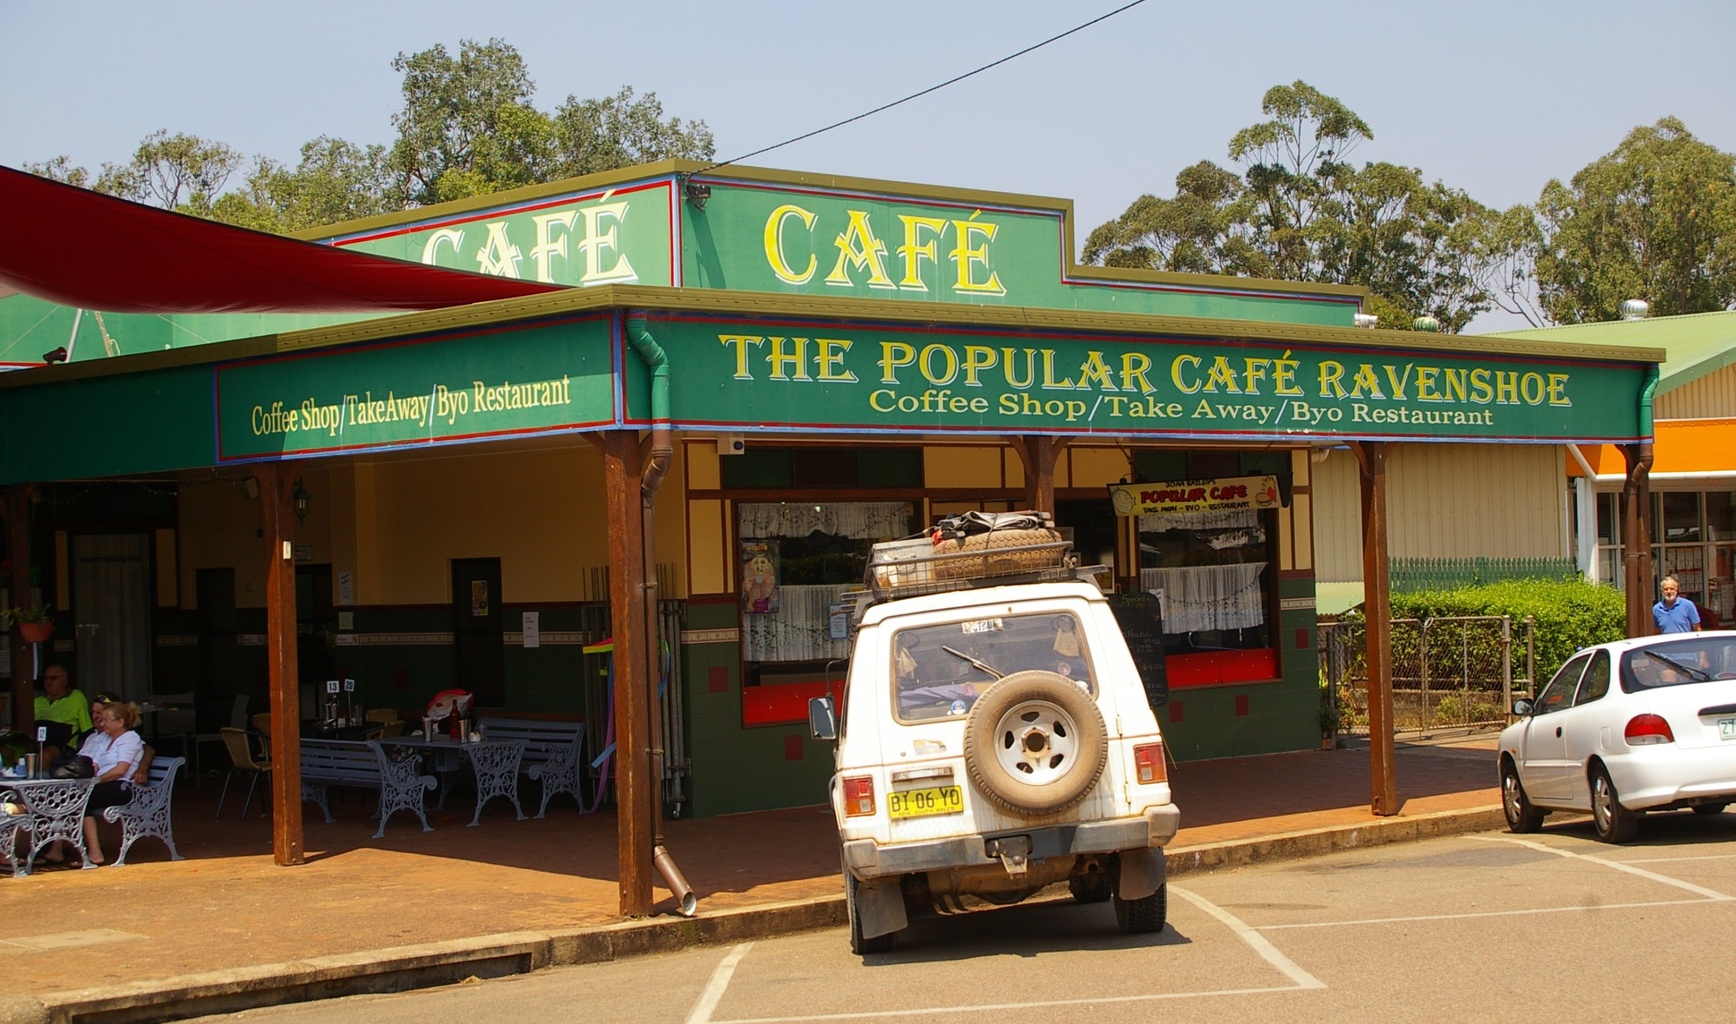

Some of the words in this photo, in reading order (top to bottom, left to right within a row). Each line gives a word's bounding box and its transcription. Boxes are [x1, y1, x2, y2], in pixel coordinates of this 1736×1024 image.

[763, 204, 1007, 296] CAFÉ
[718, 334, 859, 384] THE
[877, 341, 1156, 395] POPULAR
[1170, 349, 1304, 397] CAFÉ
[1318, 360, 1571, 407] RAVENSHOE
[252, 401, 298, 436] Coffee
[473, 374, 571, 413] Restaurant
[869, 389, 989, 414] Coffee
[1352, 403, 1493, 427] Restaurant
[1140, 487, 1207, 504] POPULAR
[1210, 485, 1248, 501] CAFE
[1142, 506, 1158, 514] TAKE
[1208, 502, 1250, 511] RESTAURANT
[329, 682, 337, 691] 13
